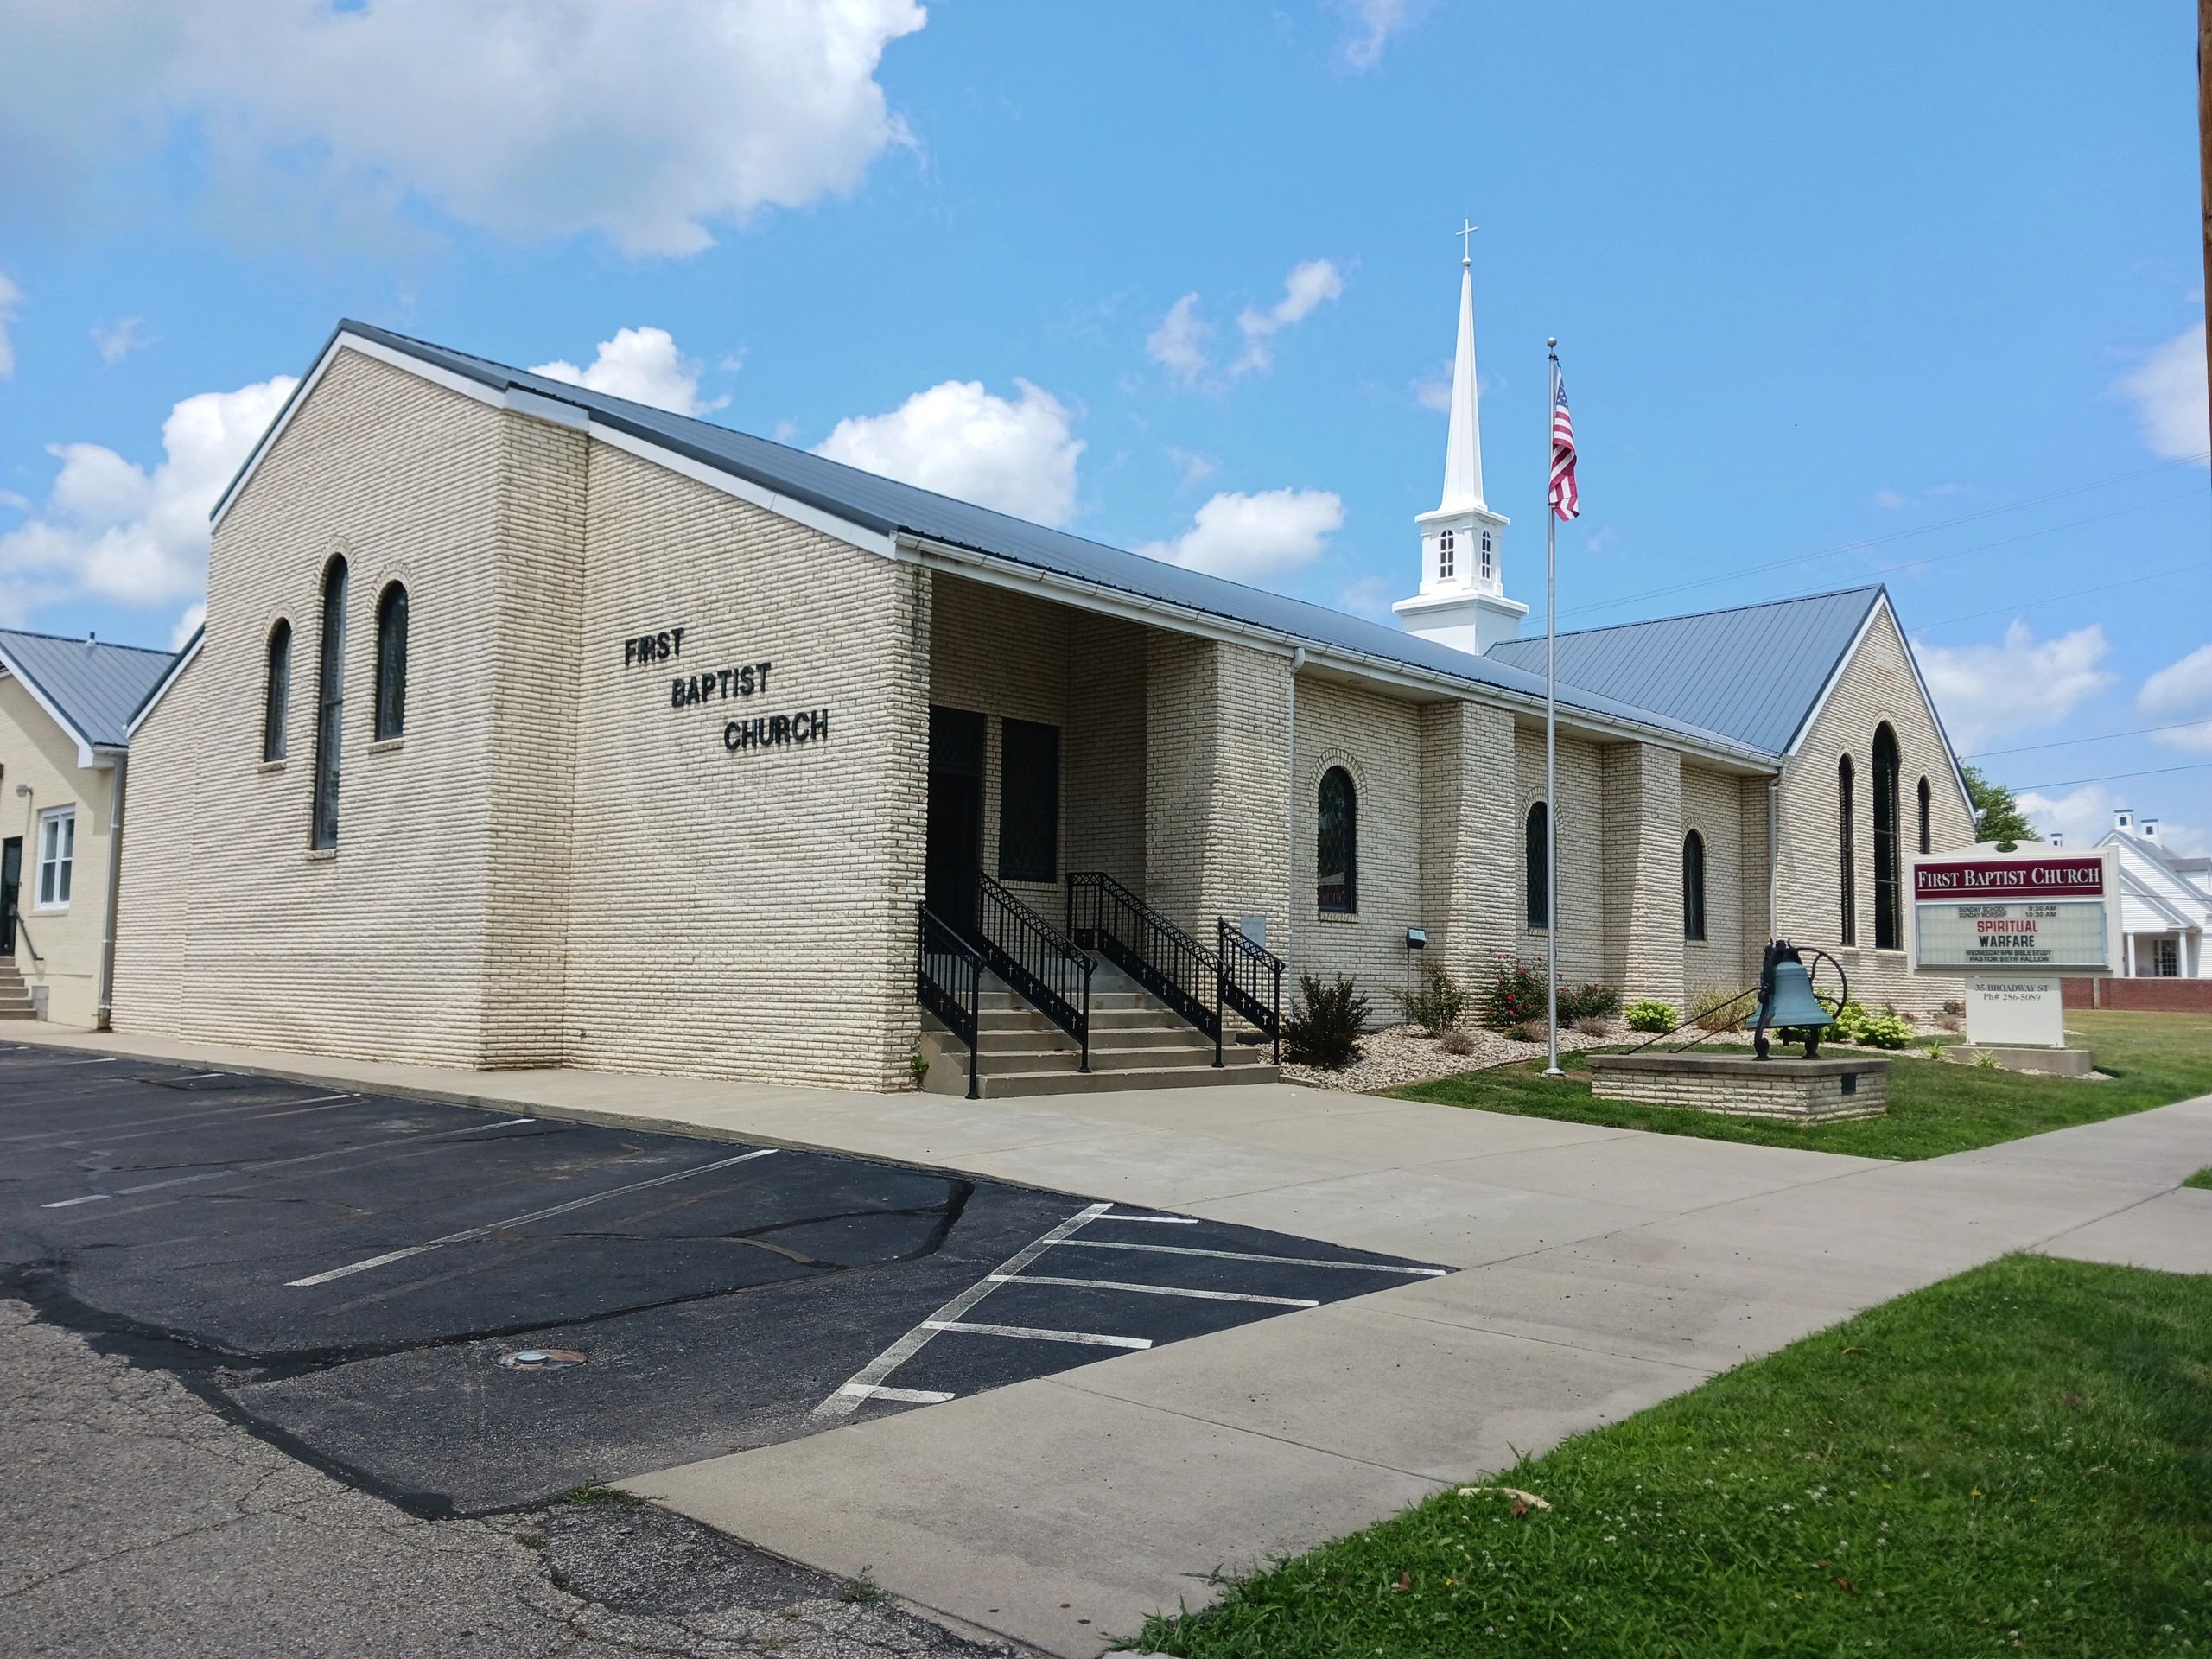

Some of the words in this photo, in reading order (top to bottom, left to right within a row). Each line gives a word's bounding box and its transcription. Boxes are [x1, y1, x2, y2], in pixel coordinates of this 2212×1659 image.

[625, 627, 684, 666] FIRST
[671, 662, 772, 707] BAPTIST
[723, 708, 829, 750] CHURCH
[1917, 870, 1959, 887] FIRST
[1964, 868, 2026, 887] BAPTIST
[2031, 867, 2100, 885] CHURCH
[1977, 920, 2038, 933] SPIRITUAL
[1979, 935, 2035, 948] WARFARE
